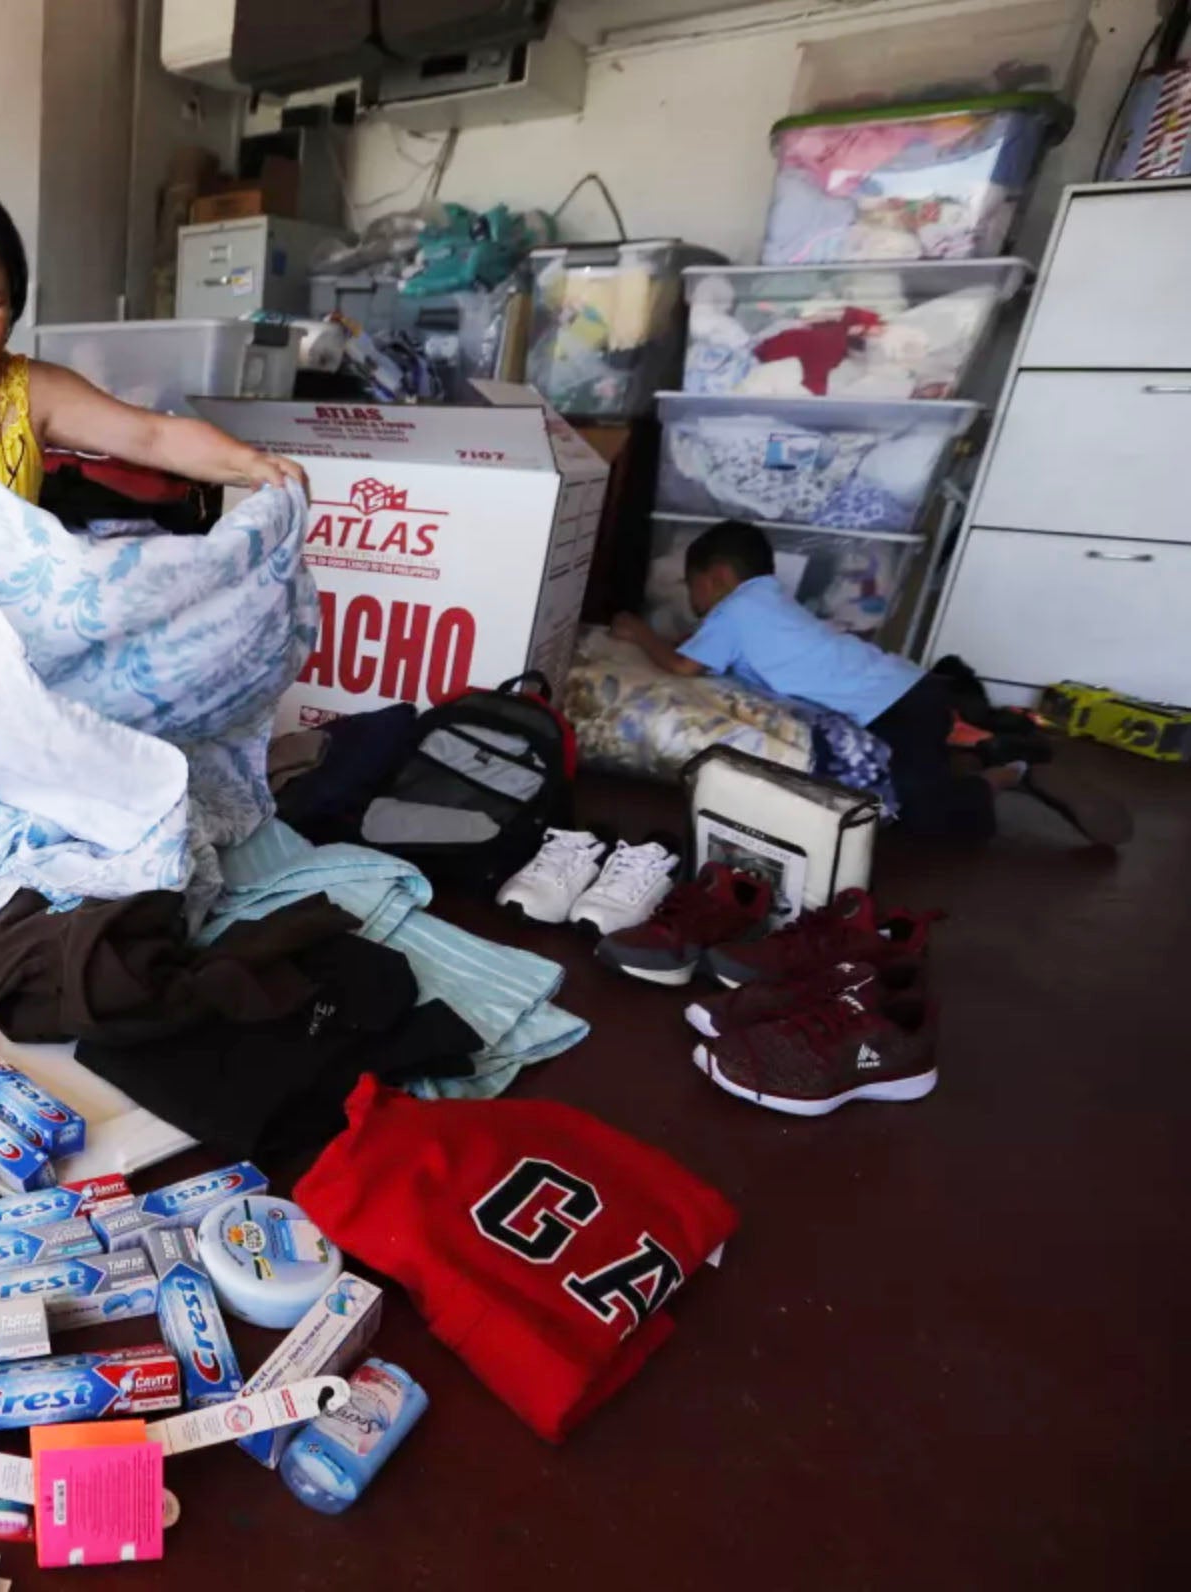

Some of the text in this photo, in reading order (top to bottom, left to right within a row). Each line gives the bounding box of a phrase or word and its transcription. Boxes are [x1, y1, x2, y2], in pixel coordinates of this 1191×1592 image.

[315, 405, 385, 421] ATLAS
[305, 514, 440, 557] ATLAS
[296, 590, 476, 708] ACHO
[8, 1073, 69, 1124] Crest
[162, 1172, 245, 1210] Crest
[106, 1256, 146, 1271] TARTAR
[173, 1276, 225, 1385] Crest
[134, 1373, 175, 1389] CAVITY
